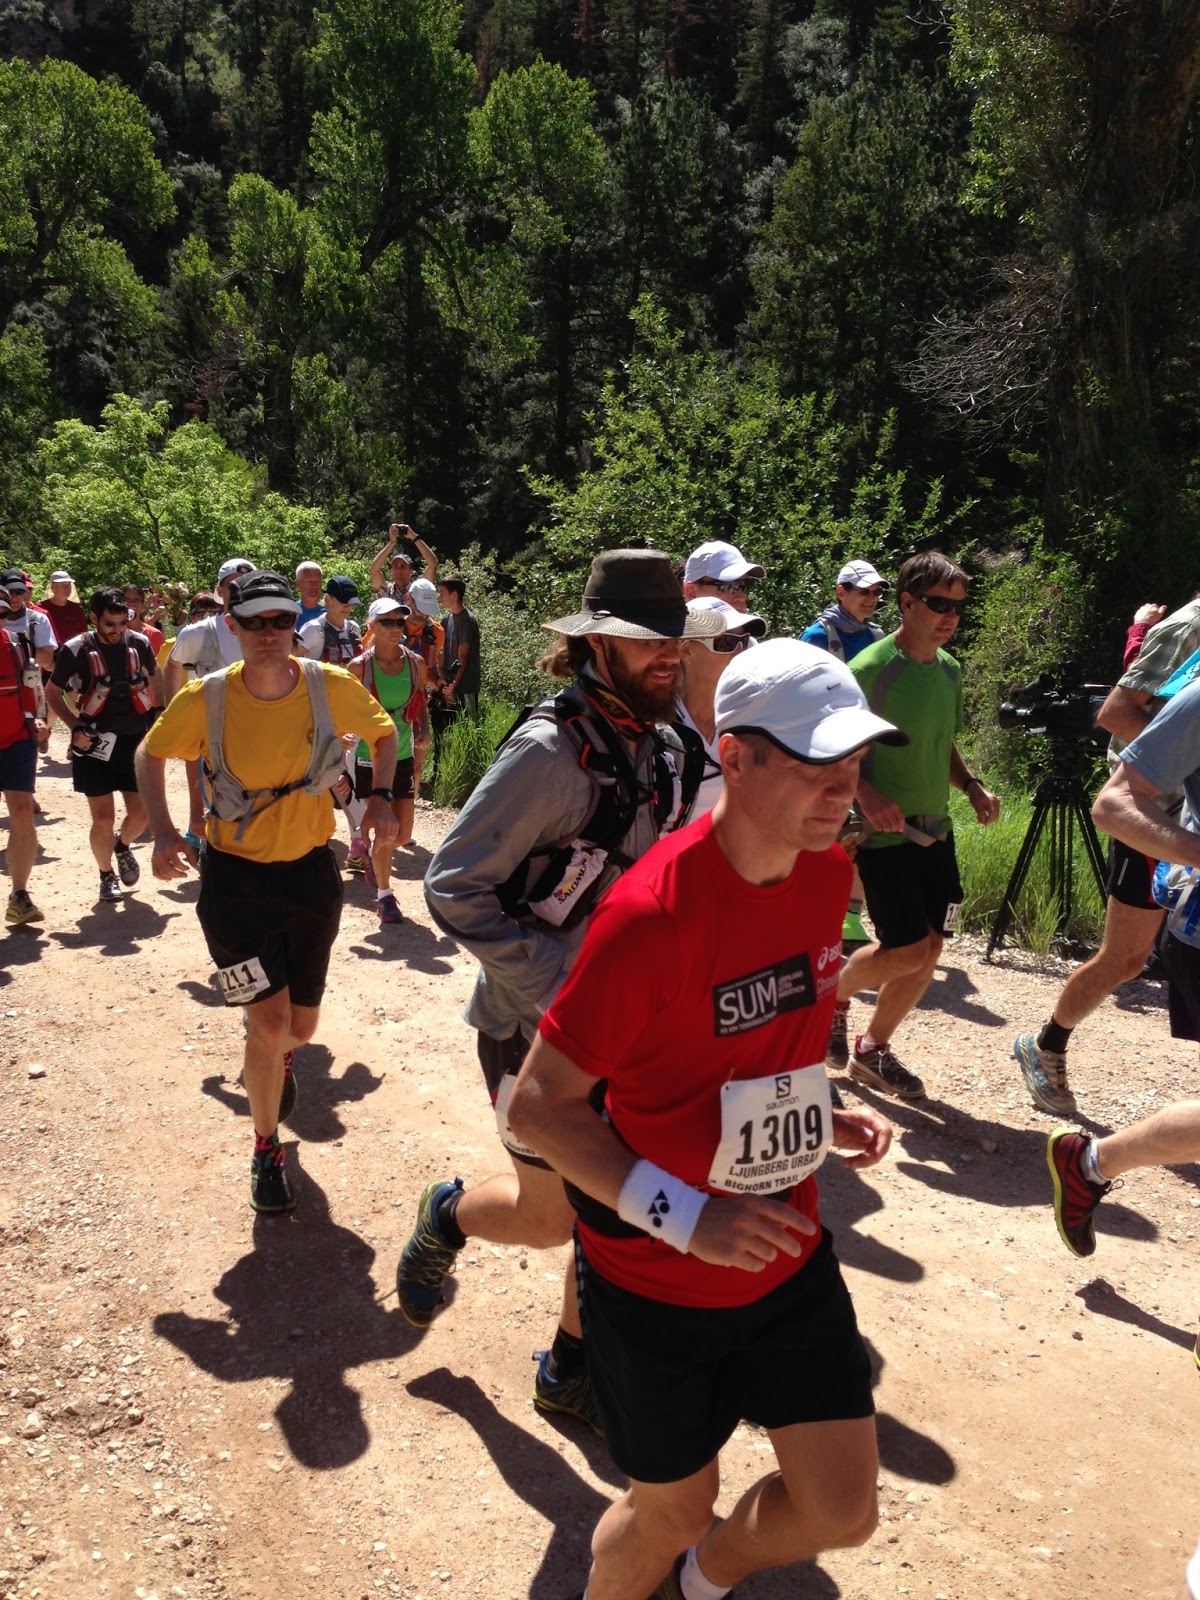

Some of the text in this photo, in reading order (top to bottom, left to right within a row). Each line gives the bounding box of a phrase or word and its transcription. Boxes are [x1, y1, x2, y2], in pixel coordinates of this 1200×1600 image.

[222, 964, 257, 992] 211
[719, 976, 777, 1026] SUM
[765, 1096, 800, 1111] salomon
[735, 1104, 823, 1165] 1309
[729, 1159, 789, 1179] LJUNGBERG
[724, 1174, 799, 1192] BIGHORN TRAIL
